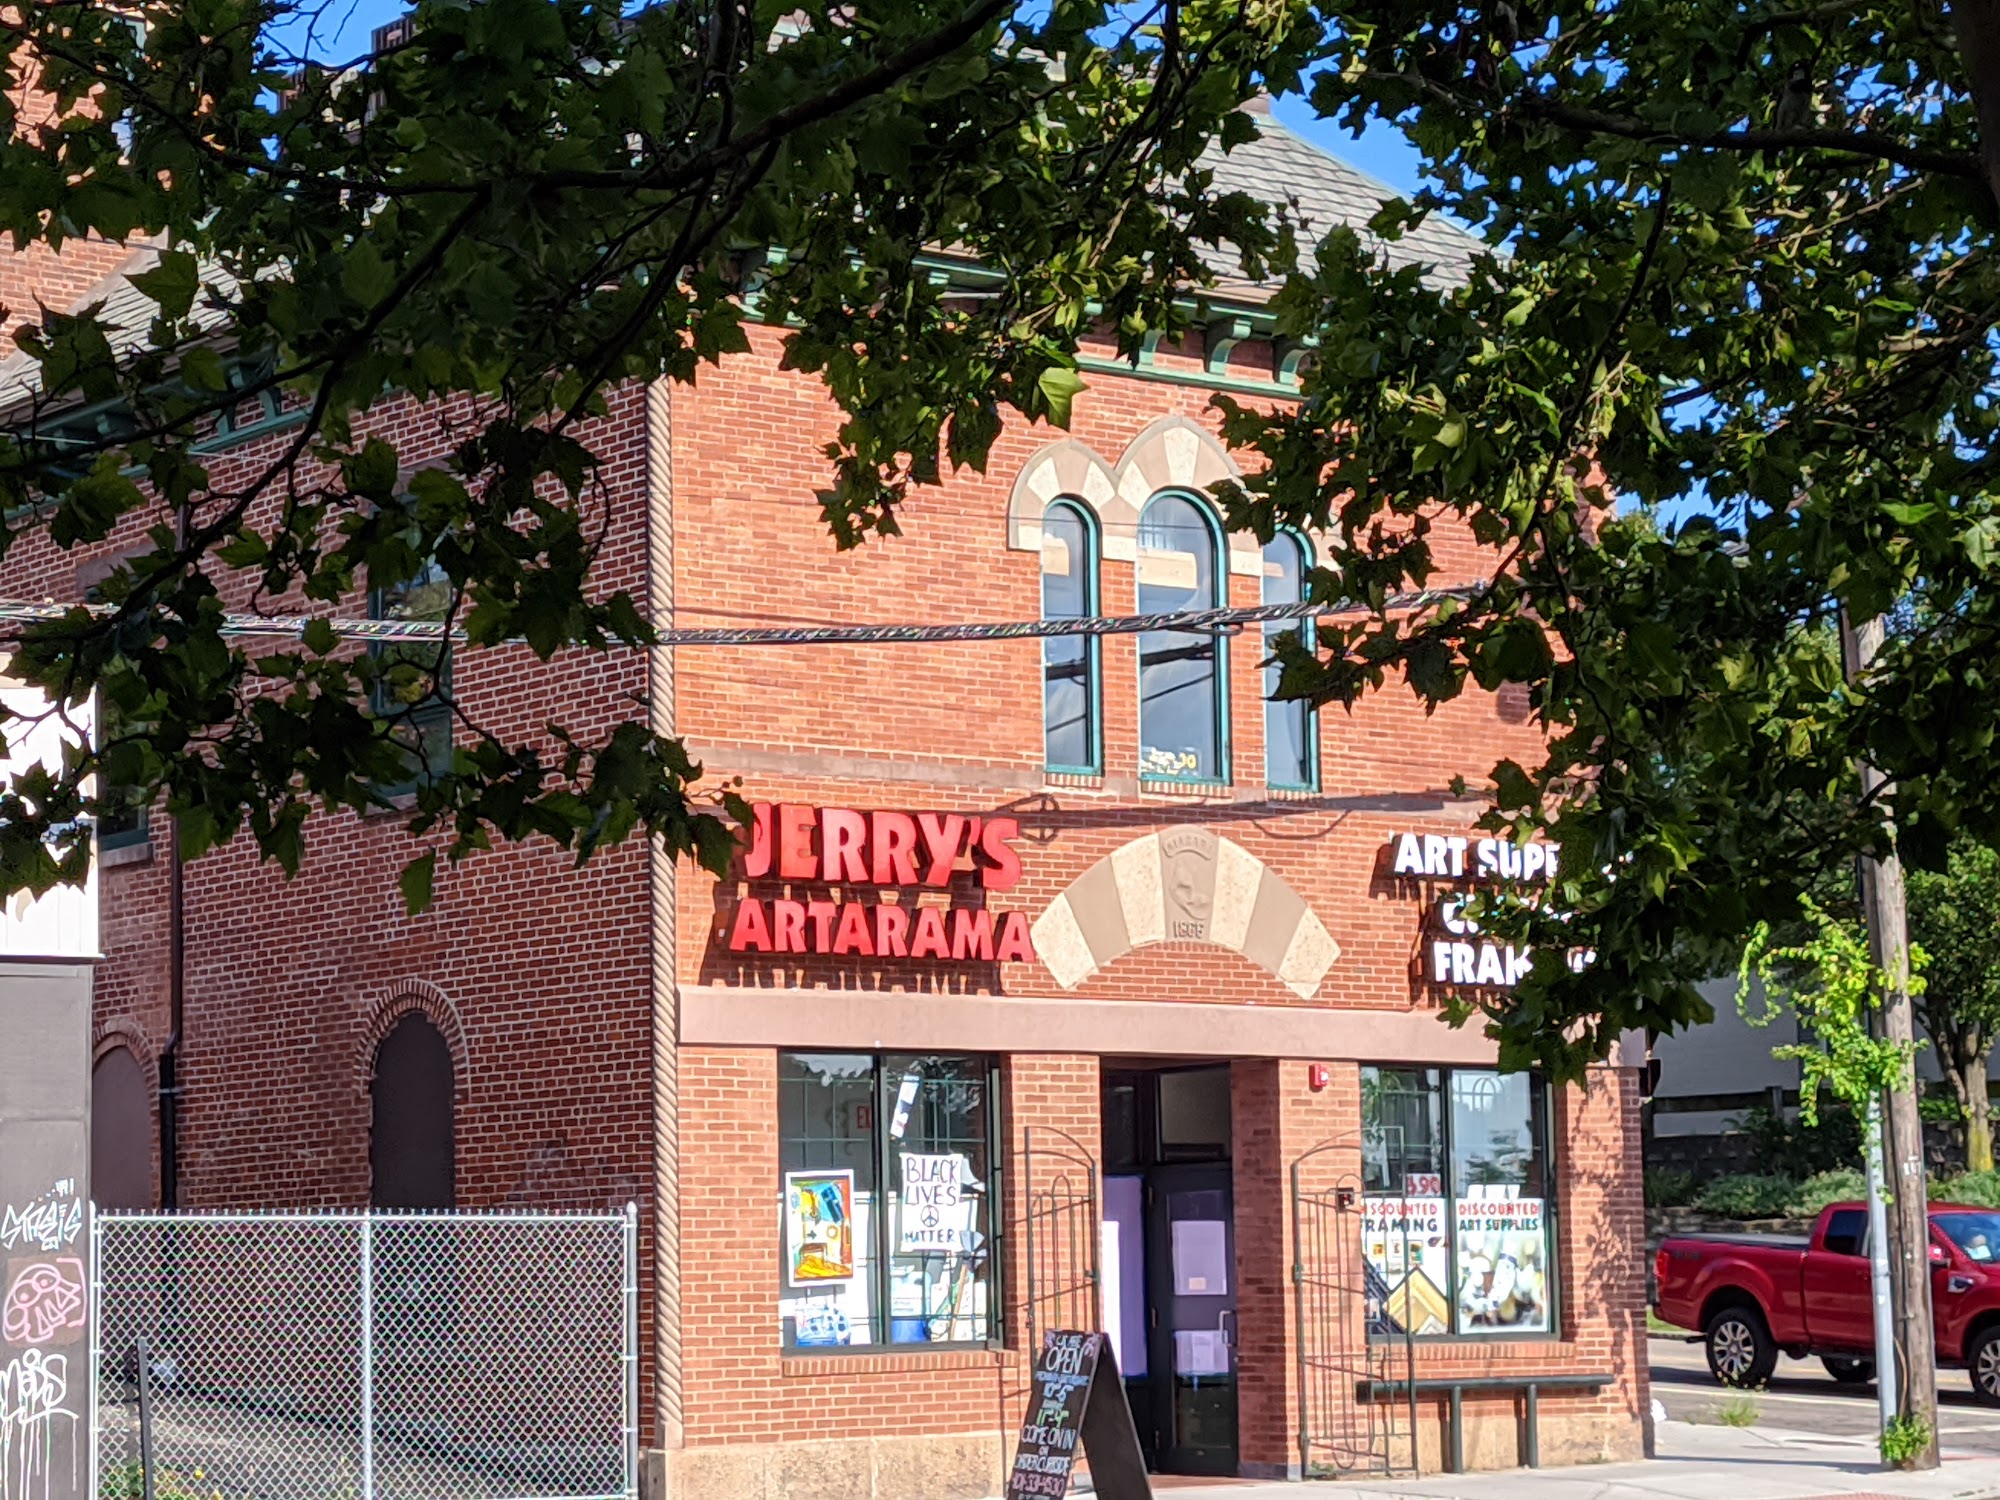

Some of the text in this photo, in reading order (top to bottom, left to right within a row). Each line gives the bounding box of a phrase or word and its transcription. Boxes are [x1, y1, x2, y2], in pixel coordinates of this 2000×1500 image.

[746, 802, 1021, 890] JERRY'S
[1394, 832, 1467, 877] ART
[730, 897, 1035, 963] ARTARAMA
[906, 1156, 959, 1185] BLACK
[905, 1184, 957, 1207] LIVES
[1458, 1202, 1540, 1216] DISCOUNTED
[1459, 1217, 1539, 1231] ART SUPPLIES
[1045, 1346, 1085, 1375] OPEN
